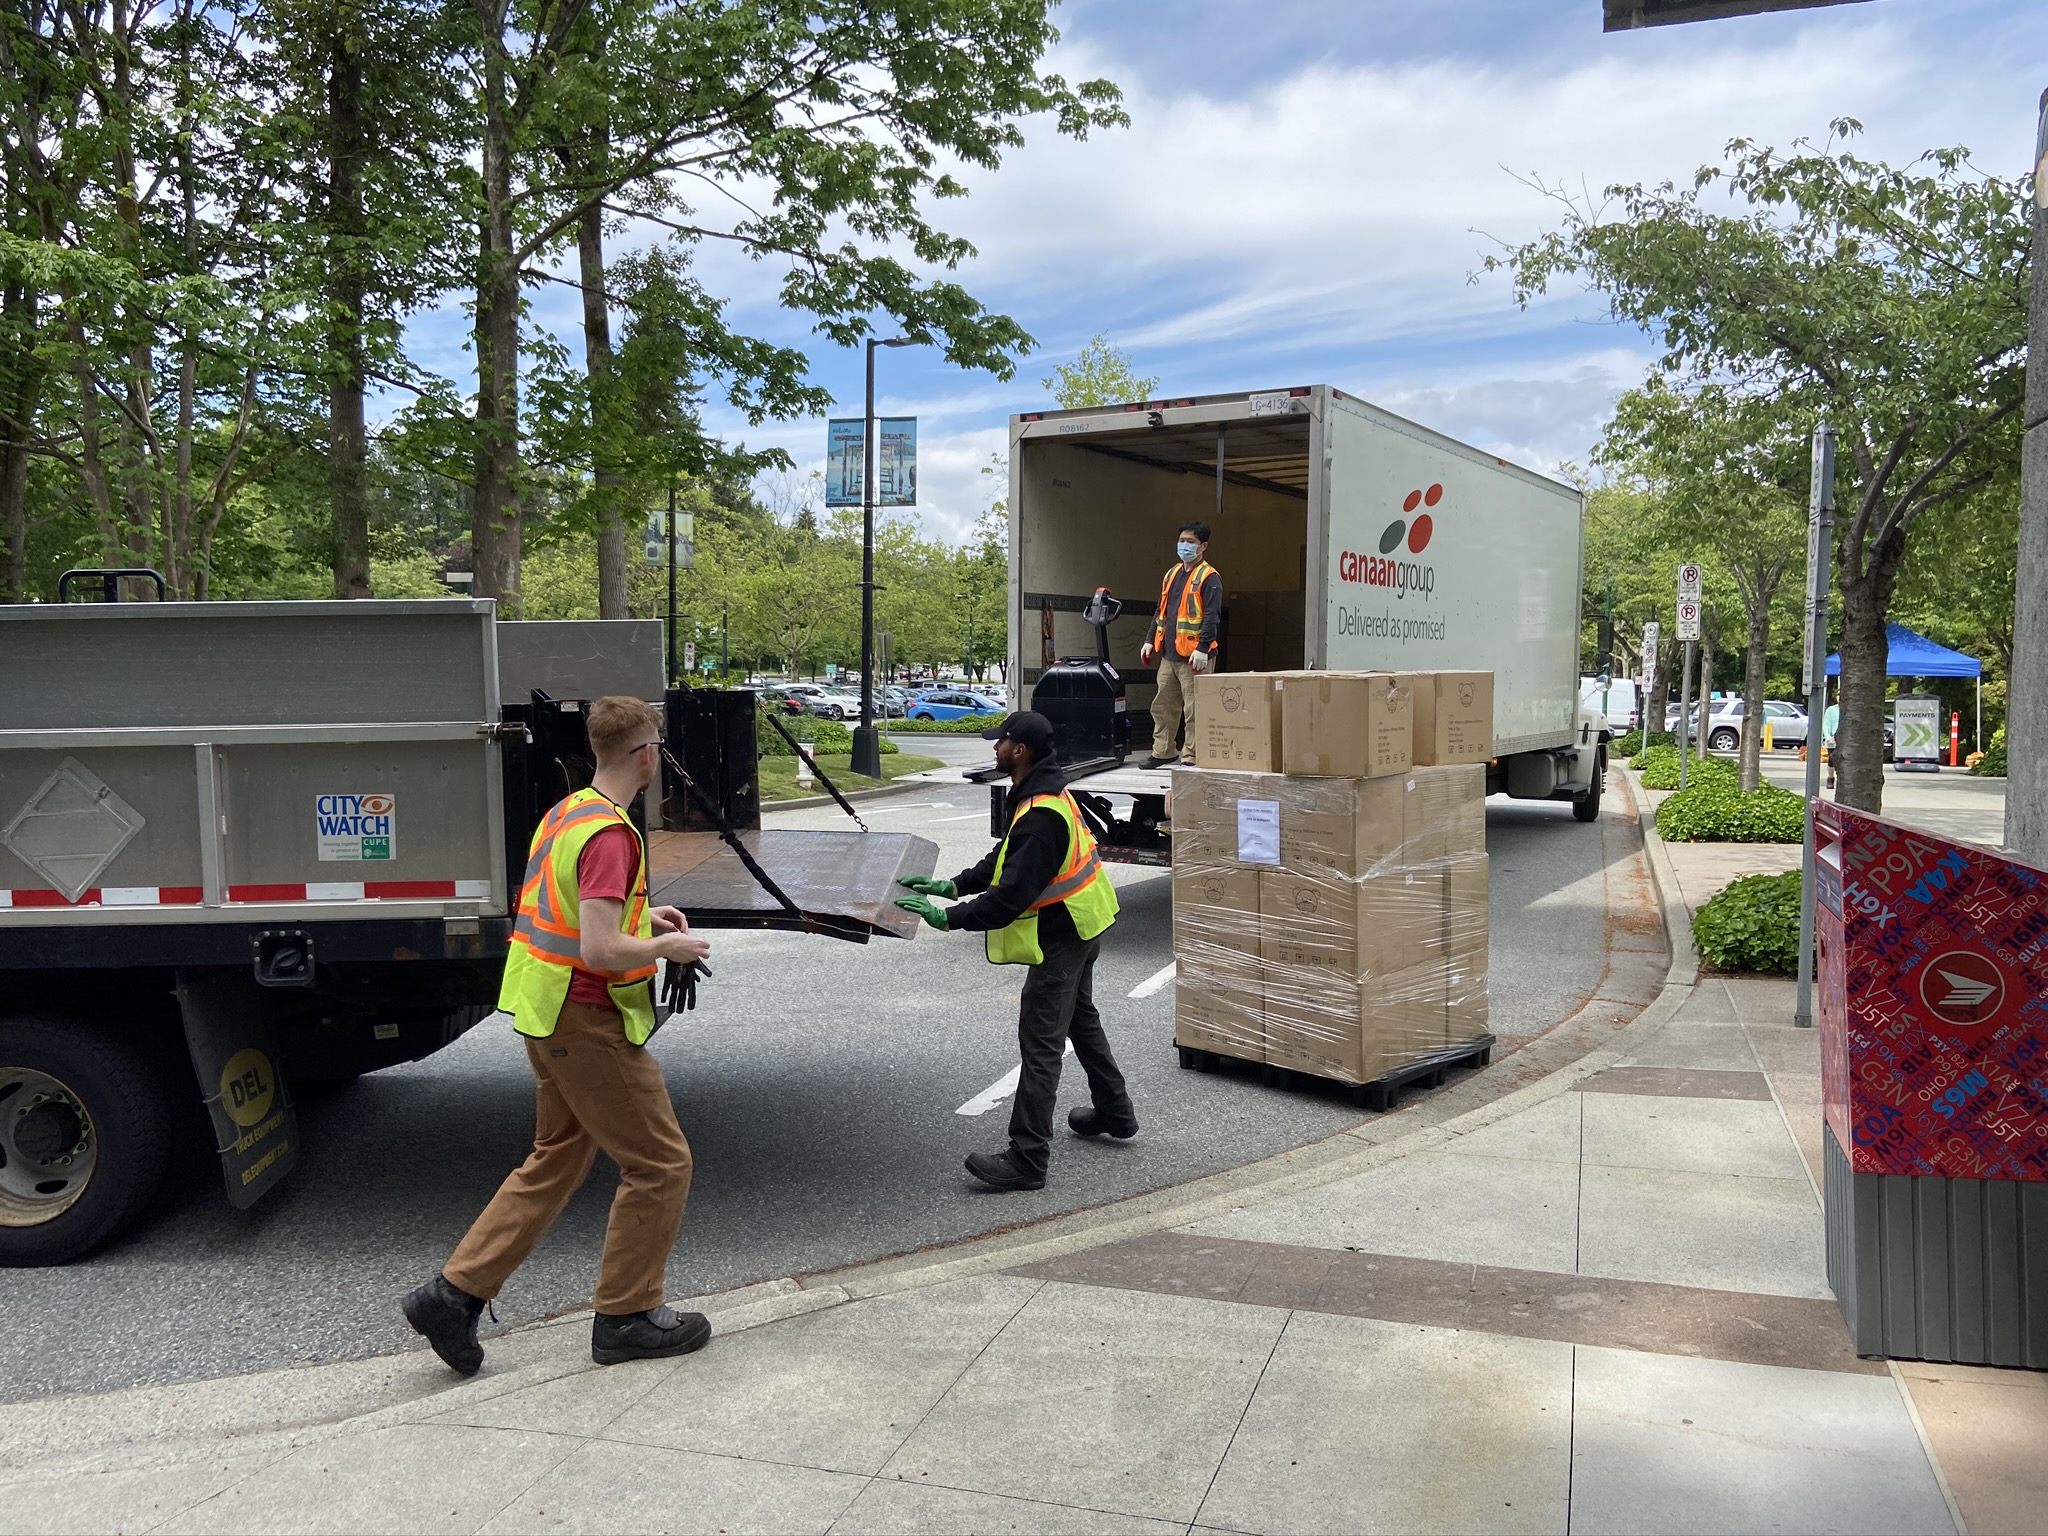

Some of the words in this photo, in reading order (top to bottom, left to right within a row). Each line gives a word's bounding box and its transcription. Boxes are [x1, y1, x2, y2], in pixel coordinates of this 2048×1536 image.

[1338, 606, 1389, 638] Delivered
[1390, 617, 1401, 639] as
[1402, 615, 1446, 647] promised
[317, 795, 364, 816] CITY
[317, 815, 389, 836] WATCH
[363, 838, 387, 846] CUPE
[1867, 838, 1940, 897] P9A
[1904, 849, 1970, 904] K4A
[2005, 863, 2042, 889] S4N
[1843, 880, 1897, 930] H9X
[1944, 874, 1975, 901] E3N
[1974, 877, 2016, 915] V7J
[1928, 897, 1973, 936] B4E
[1963, 902, 1998, 925] J5T
[2000, 910, 2048, 952] M9L
[1867, 919, 1912, 956] V6K
[1884, 943, 1914, 967] V1X
[1916, 927, 1942, 948] B2Z
[1845, 940, 1879, 973] X1A
[1856, 1004, 1891, 1028] J5T
[1864, 978, 1906, 1017] V7J
[1879, 1012, 1920, 1040] V9L
[1869, 1036, 1902, 1067] T9K
[1901, 1043, 1933, 1075] A1B
[1931, 1055, 1960, 1081] P9A
[2000, 1032, 2048, 1069] V6K
[229, 1067, 268, 1110] DEL
[1860, 1061, 1913, 1107] G3N
[1975, 1054, 2011, 1089] X1A
[1931, 1067, 1990, 1120] M6S
[1965, 1089, 1998, 1118] E3N
[1985, 1117, 2022, 1143] J5T
[1996, 1093, 2037, 1132] V7J
[236, 1131, 256, 1156] TRUCK
[254, 1110, 286, 1143] EQUIPMENT
[1873, 1120, 1913, 1161] J6W
[1949, 1110, 2006, 1158] B4E
[1945, 1137, 1989, 1174] G3N
